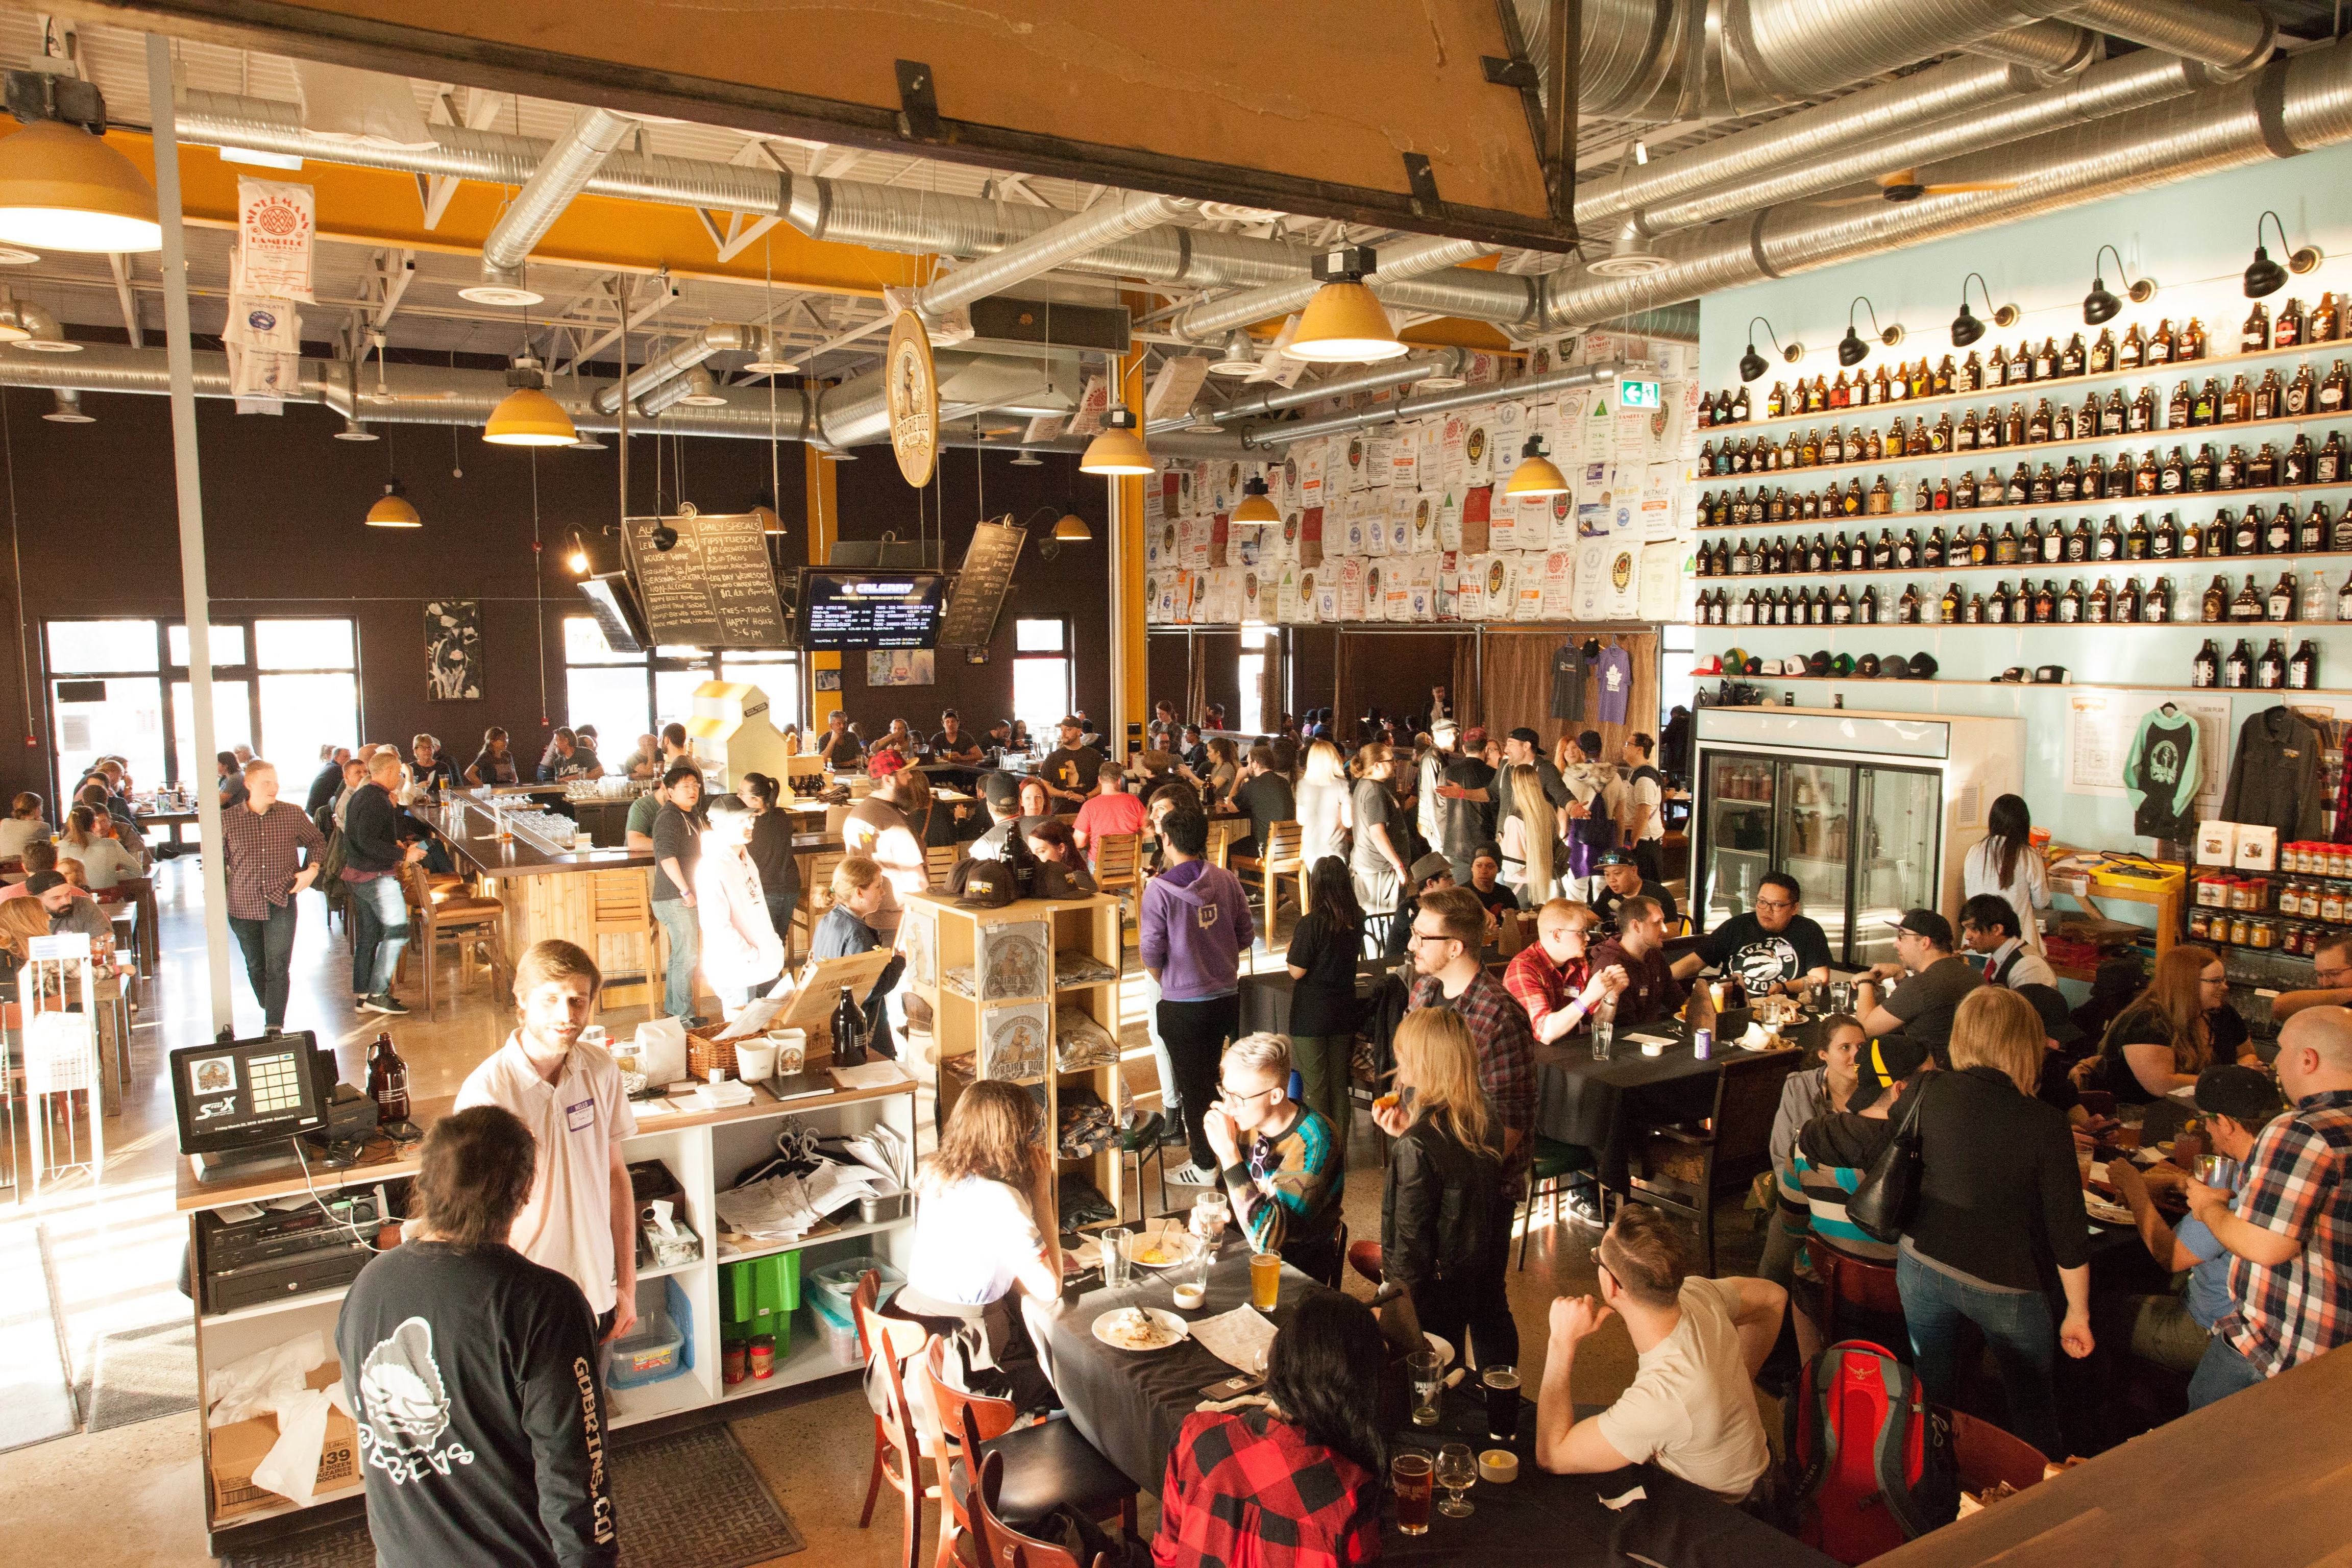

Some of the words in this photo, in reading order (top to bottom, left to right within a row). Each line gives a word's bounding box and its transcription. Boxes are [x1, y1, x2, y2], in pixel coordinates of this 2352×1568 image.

[242, 301, 285, 310] CHOCOLATE
[917, 415, 929, 431] DOG
[699, 522, 724, 531] DAILY
[724, 535, 758, 545] TUESDAY
[720, 545, 749, 554] GROWLER
[749, 544, 763, 552] FILLS
[643, 553, 666, 564] HOUSE
[670, 553, 689, 561] WINE
[735, 571, 768, 580] WEDNESDAY
[649, 583, 694, 594] NON-ALCOHOL
[856, 583, 914, 594] CALGARY
[720, 606, 740, 615] TUES
[745, 605, 772, 614] THURS
[725, 617, 749, 628] HAPPY
[752, 617, 776, 626] HOUR
[731, 628, 749, 636] 3-6
[993, 1061, 1025, 1077] PRAIRIE
[1027, 1060, 1044, 1071] DOG
[326, 1460, 351, 1471] DOZEN
